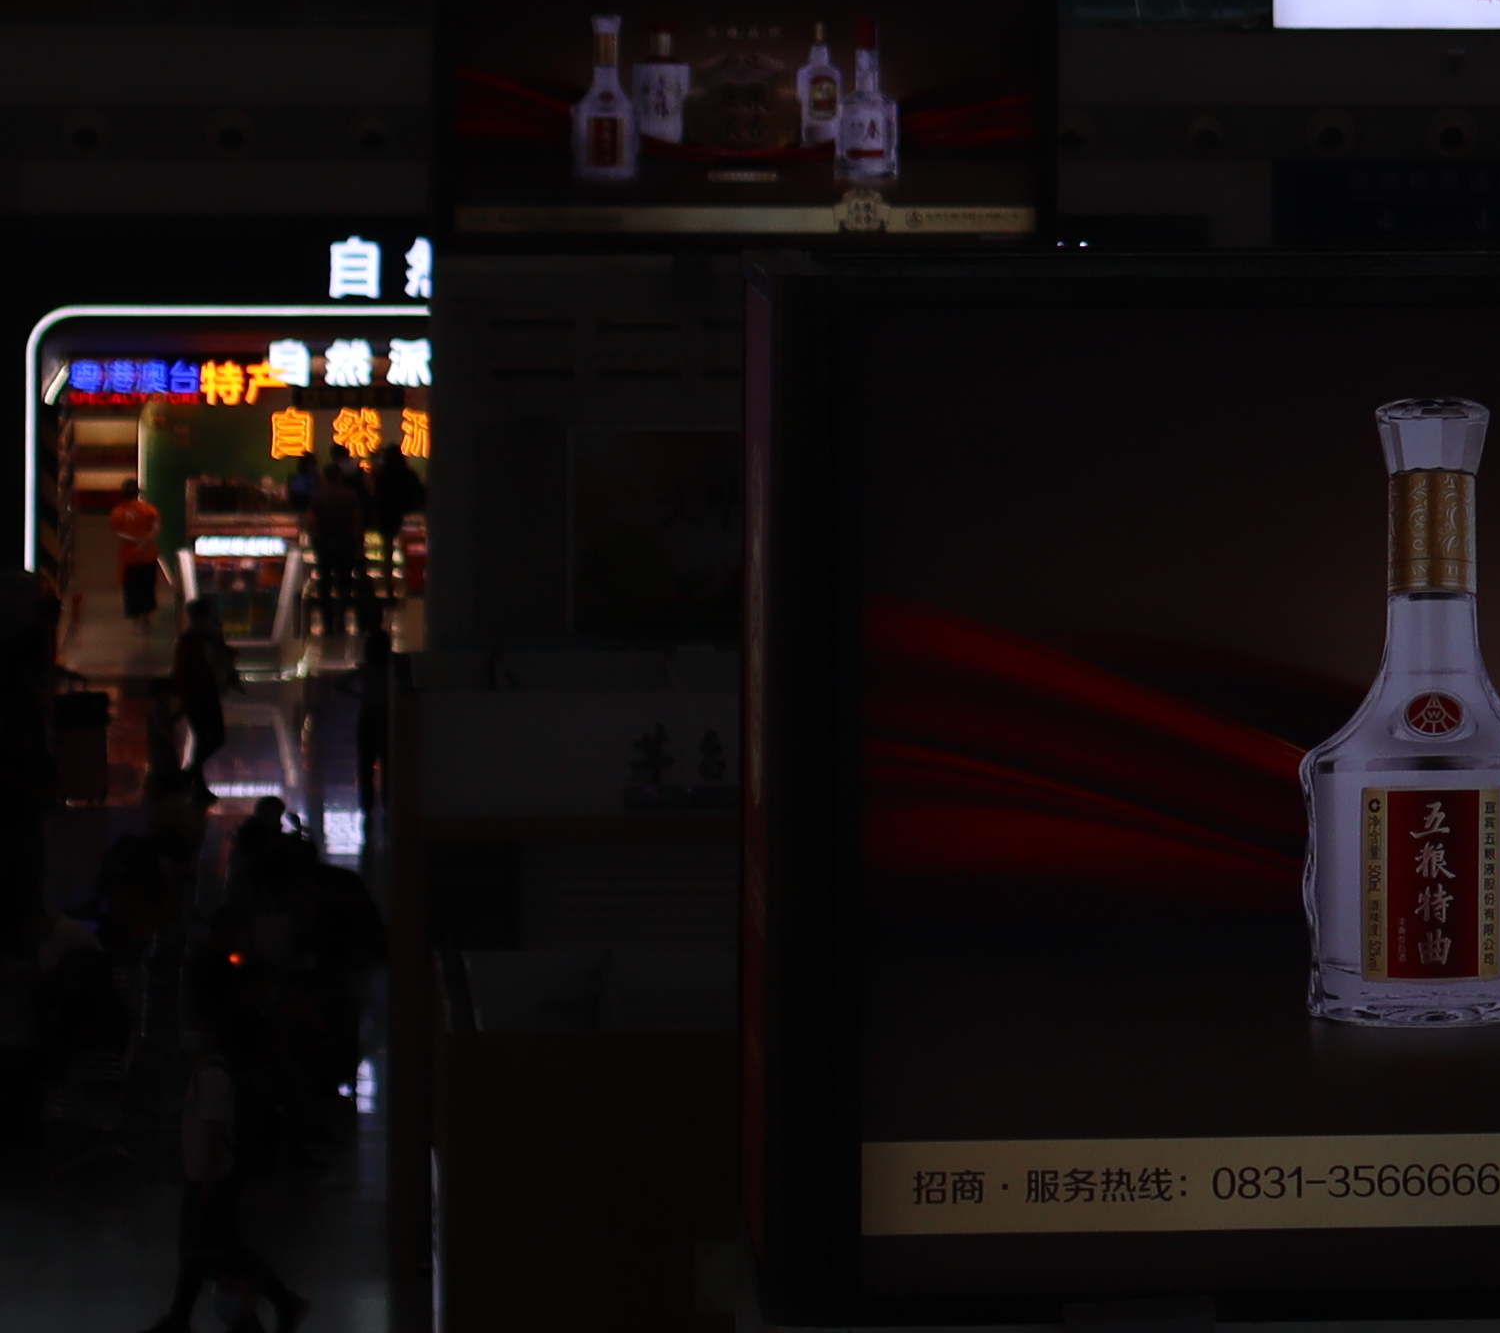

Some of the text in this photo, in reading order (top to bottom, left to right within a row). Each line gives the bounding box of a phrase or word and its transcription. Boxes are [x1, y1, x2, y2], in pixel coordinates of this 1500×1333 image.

[1409, 800, 1457, 968] 五粮特曲
[1483, 800, 1496, 966] 宜宾五粮液股份有限公司
